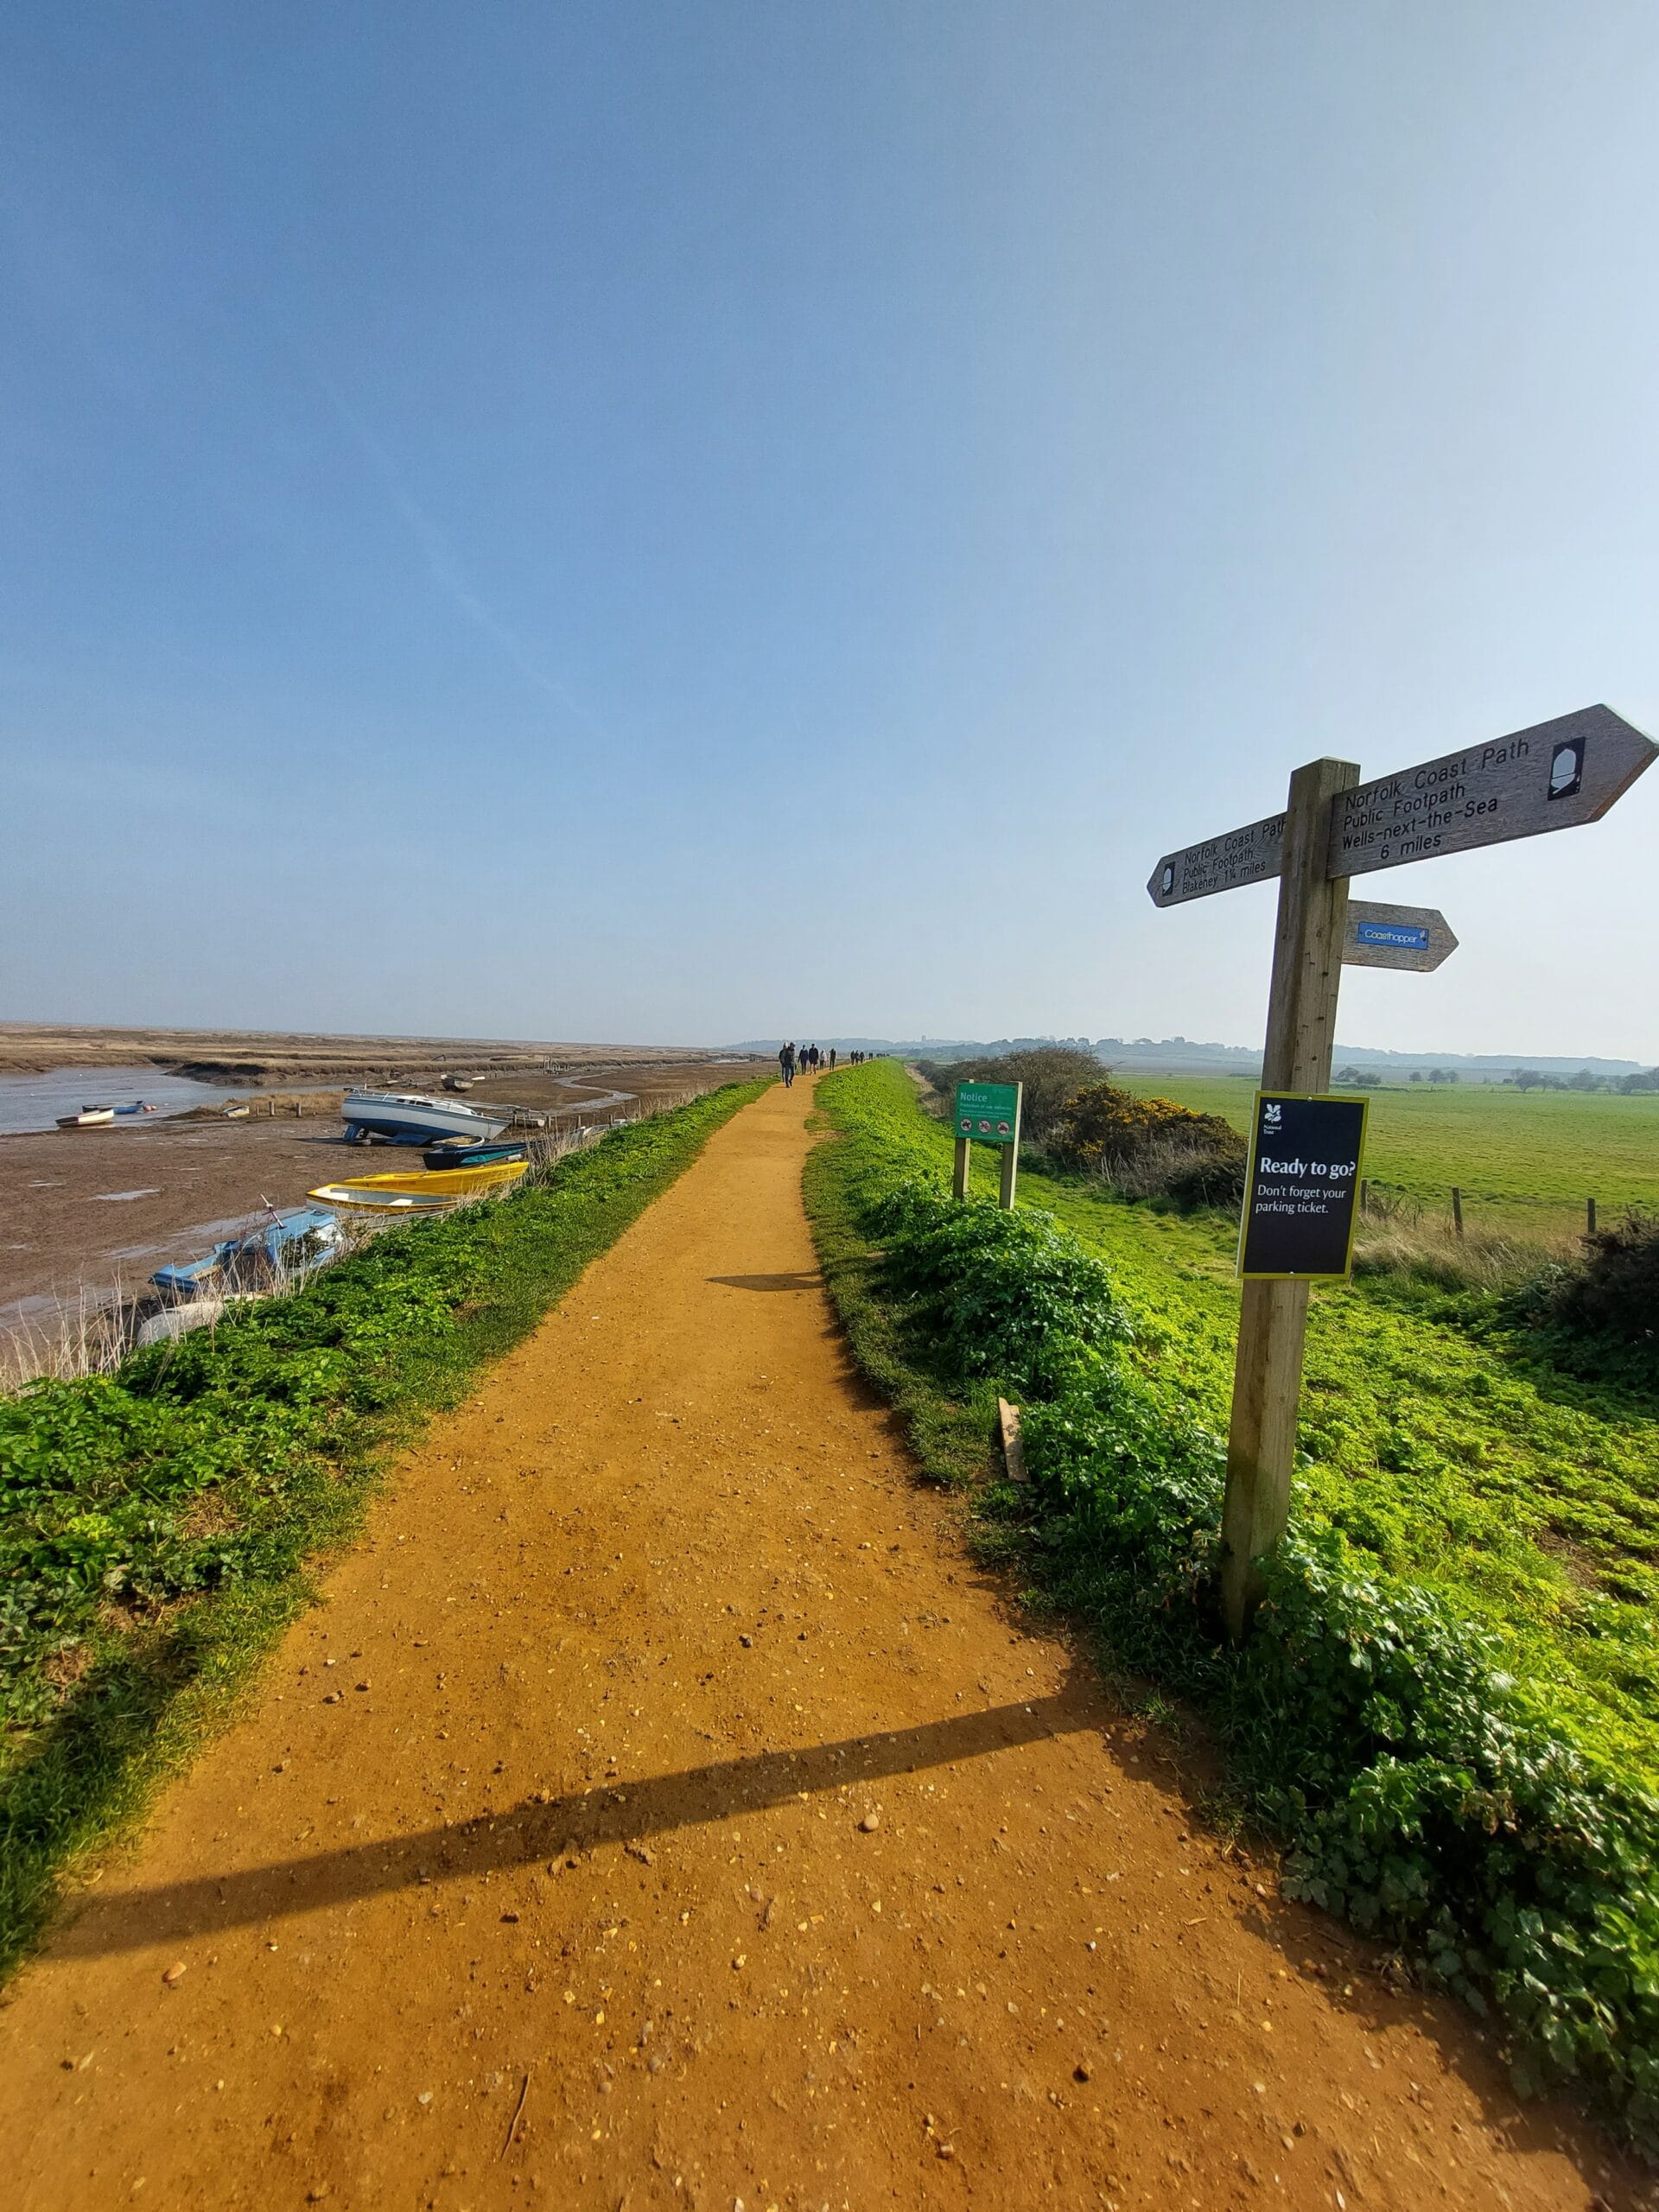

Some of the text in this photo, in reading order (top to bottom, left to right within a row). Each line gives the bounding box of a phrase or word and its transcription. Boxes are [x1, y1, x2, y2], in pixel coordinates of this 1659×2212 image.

[1345, 739, 1529, 811] Norfolk Coast Path
[1343, 783, 1465, 831] Public Footpath
[1342, 798, 1498, 850] Wells-next-the-Sea
[1185, 843, 1218, 865] Norfolk
[1224, 830, 1254, 851] Coast
[1381, 835, 1441, 859] 6 miles
[1182, 875, 1218, 894] Blakeney
[1240, 861, 1266, 878] miles
[1183, 848, 1254, 880] Public Footpath
[1364, 929, 1418, 944] Coasthopper
[960, 1092, 988, 1103] Notice
[1260, 1157, 1357, 1179] Ready to go?
[1257, 1185, 1347, 1200] Don't forget your
[1255, 1201, 1329, 1215] parking ticket.
